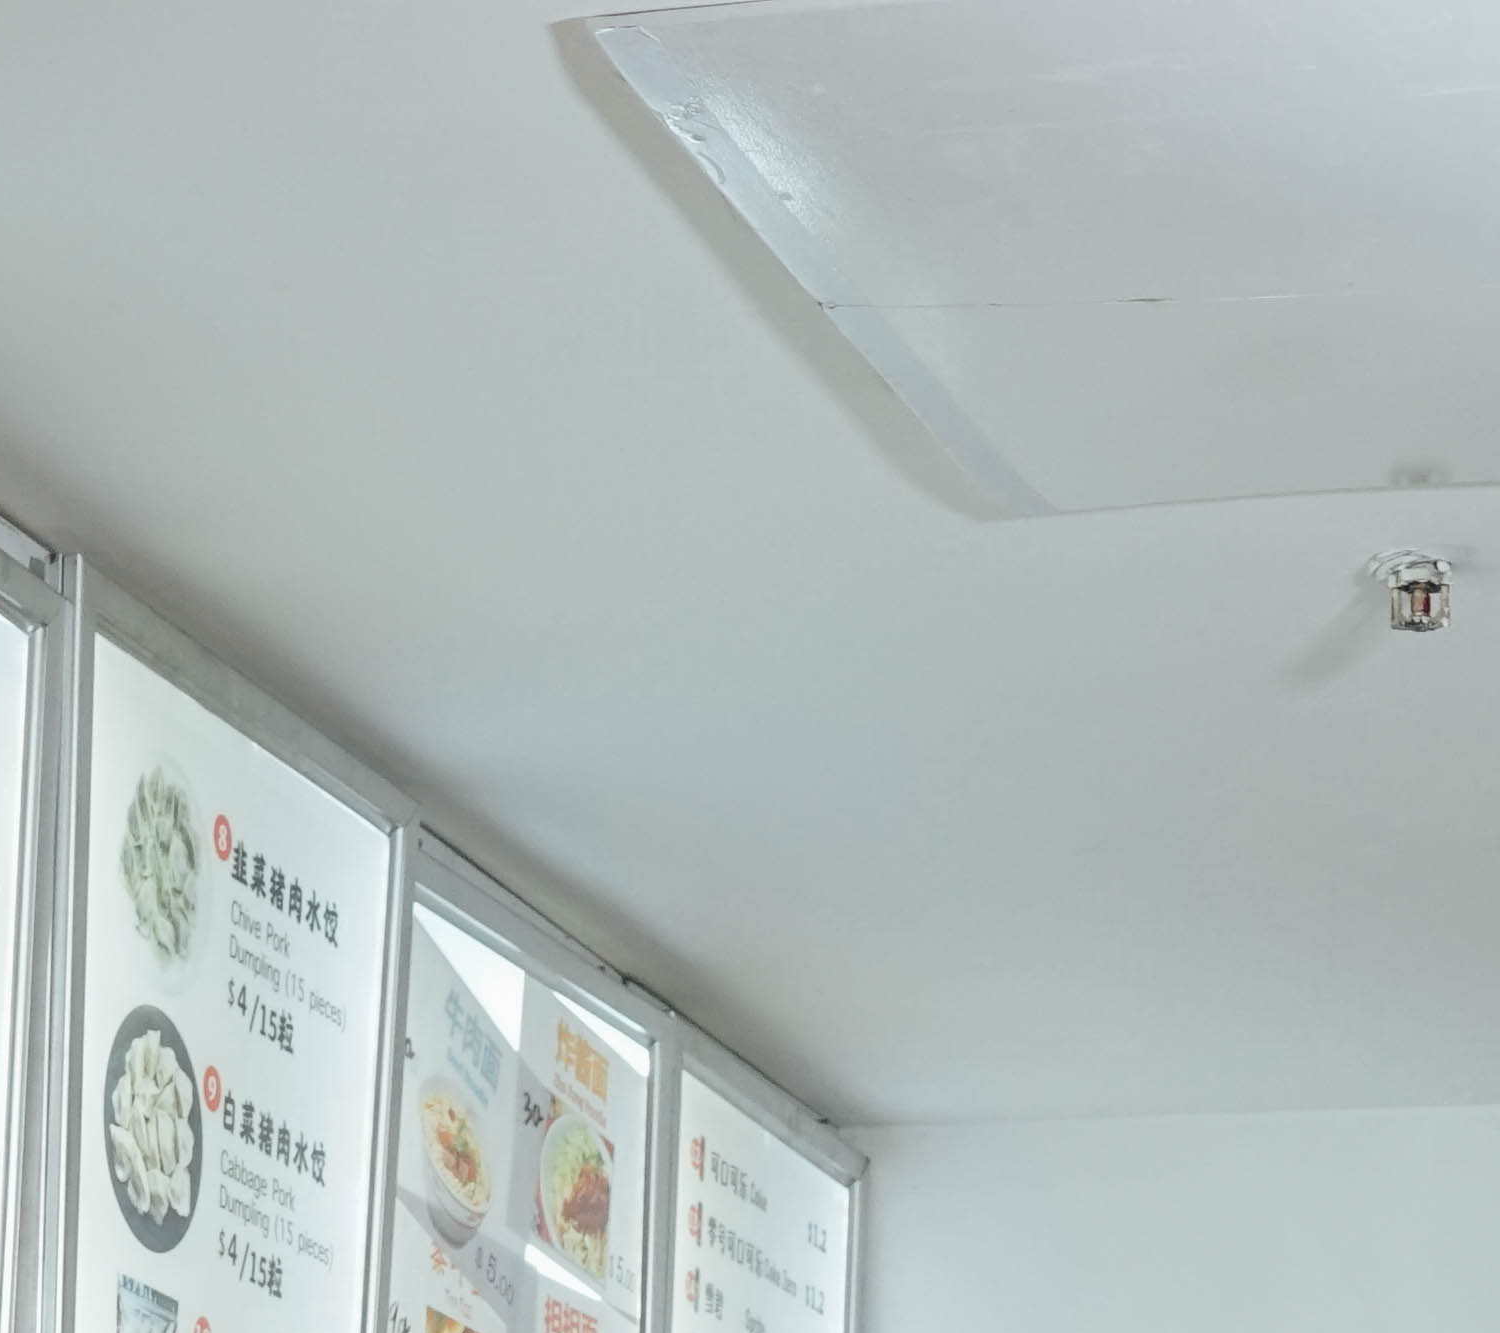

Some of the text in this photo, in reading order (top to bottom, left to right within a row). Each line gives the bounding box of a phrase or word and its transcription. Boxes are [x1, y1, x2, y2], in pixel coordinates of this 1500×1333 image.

[230, 840, 339, 949] 韭菜猪肉水饺
[230, 899, 291, 958] Chive Pork
[228, 932, 281, 994] Dumpling
[222, 1089, 326, 1188] 白菜猪肉水饺
[218, 1183, 271, 1240] Dumpling
[219, 1148, 296, 1212] Cabbage Pork
